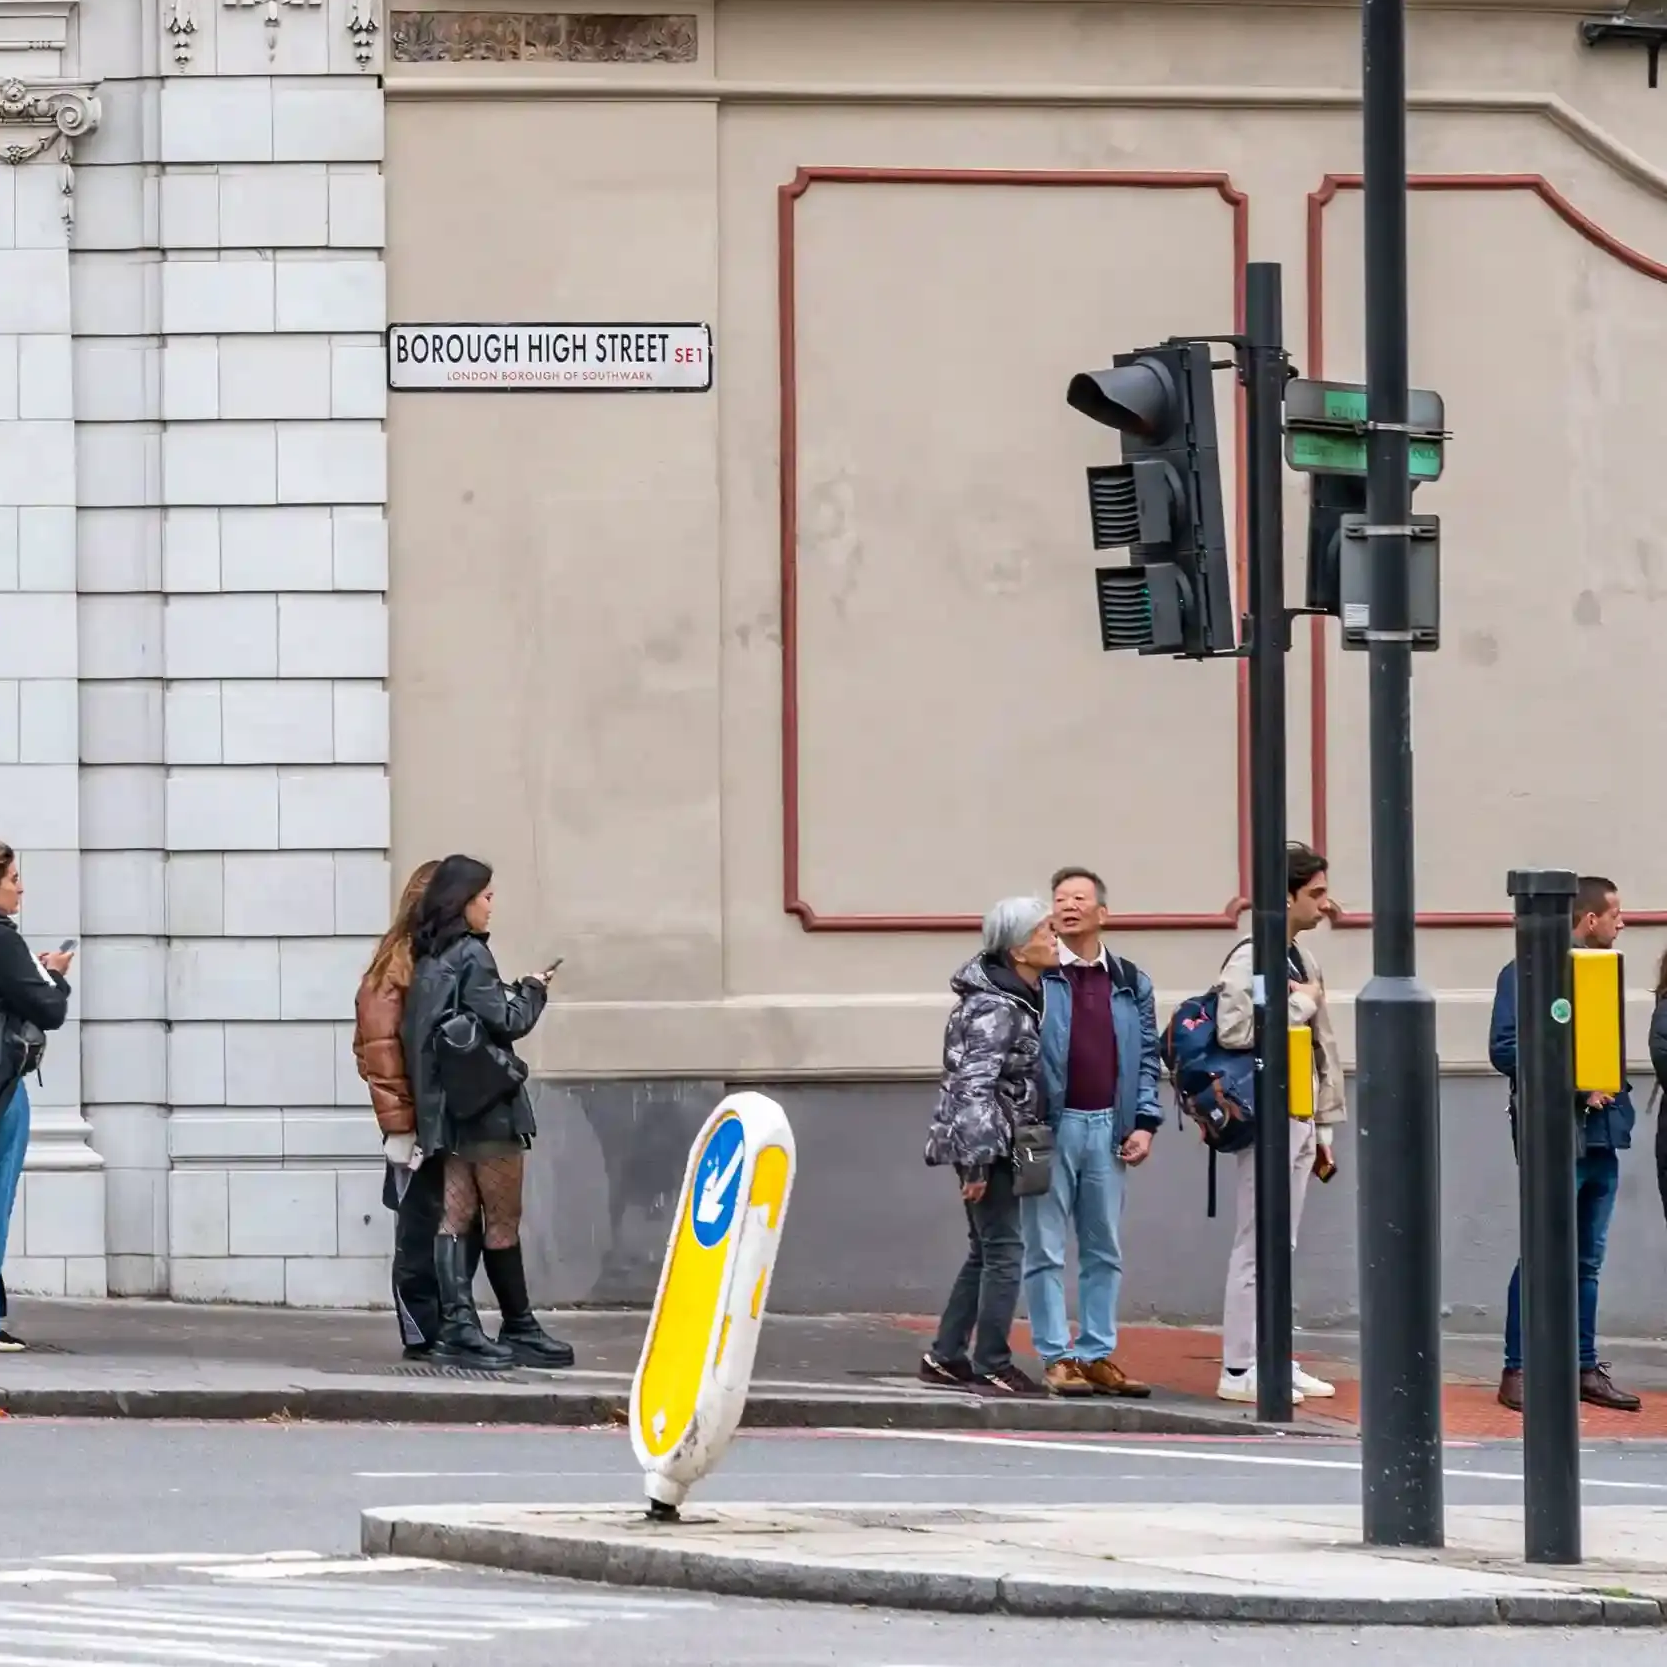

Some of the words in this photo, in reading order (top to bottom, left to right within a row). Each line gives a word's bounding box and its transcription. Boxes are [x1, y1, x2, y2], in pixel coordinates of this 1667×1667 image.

[397, 333, 518, 363] BOROUGH
[528, 333, 587, 363] HIGH
[595, 333, 669, 363] STREET
[674, 347, 703, 363] SE1
[447, 371, 497, 382] LONDON
[502, 371, 560, 382] BOROUGH
[563, 371, 579, 382] OF
[582, 371, 653, 382] SOUTHWARK
